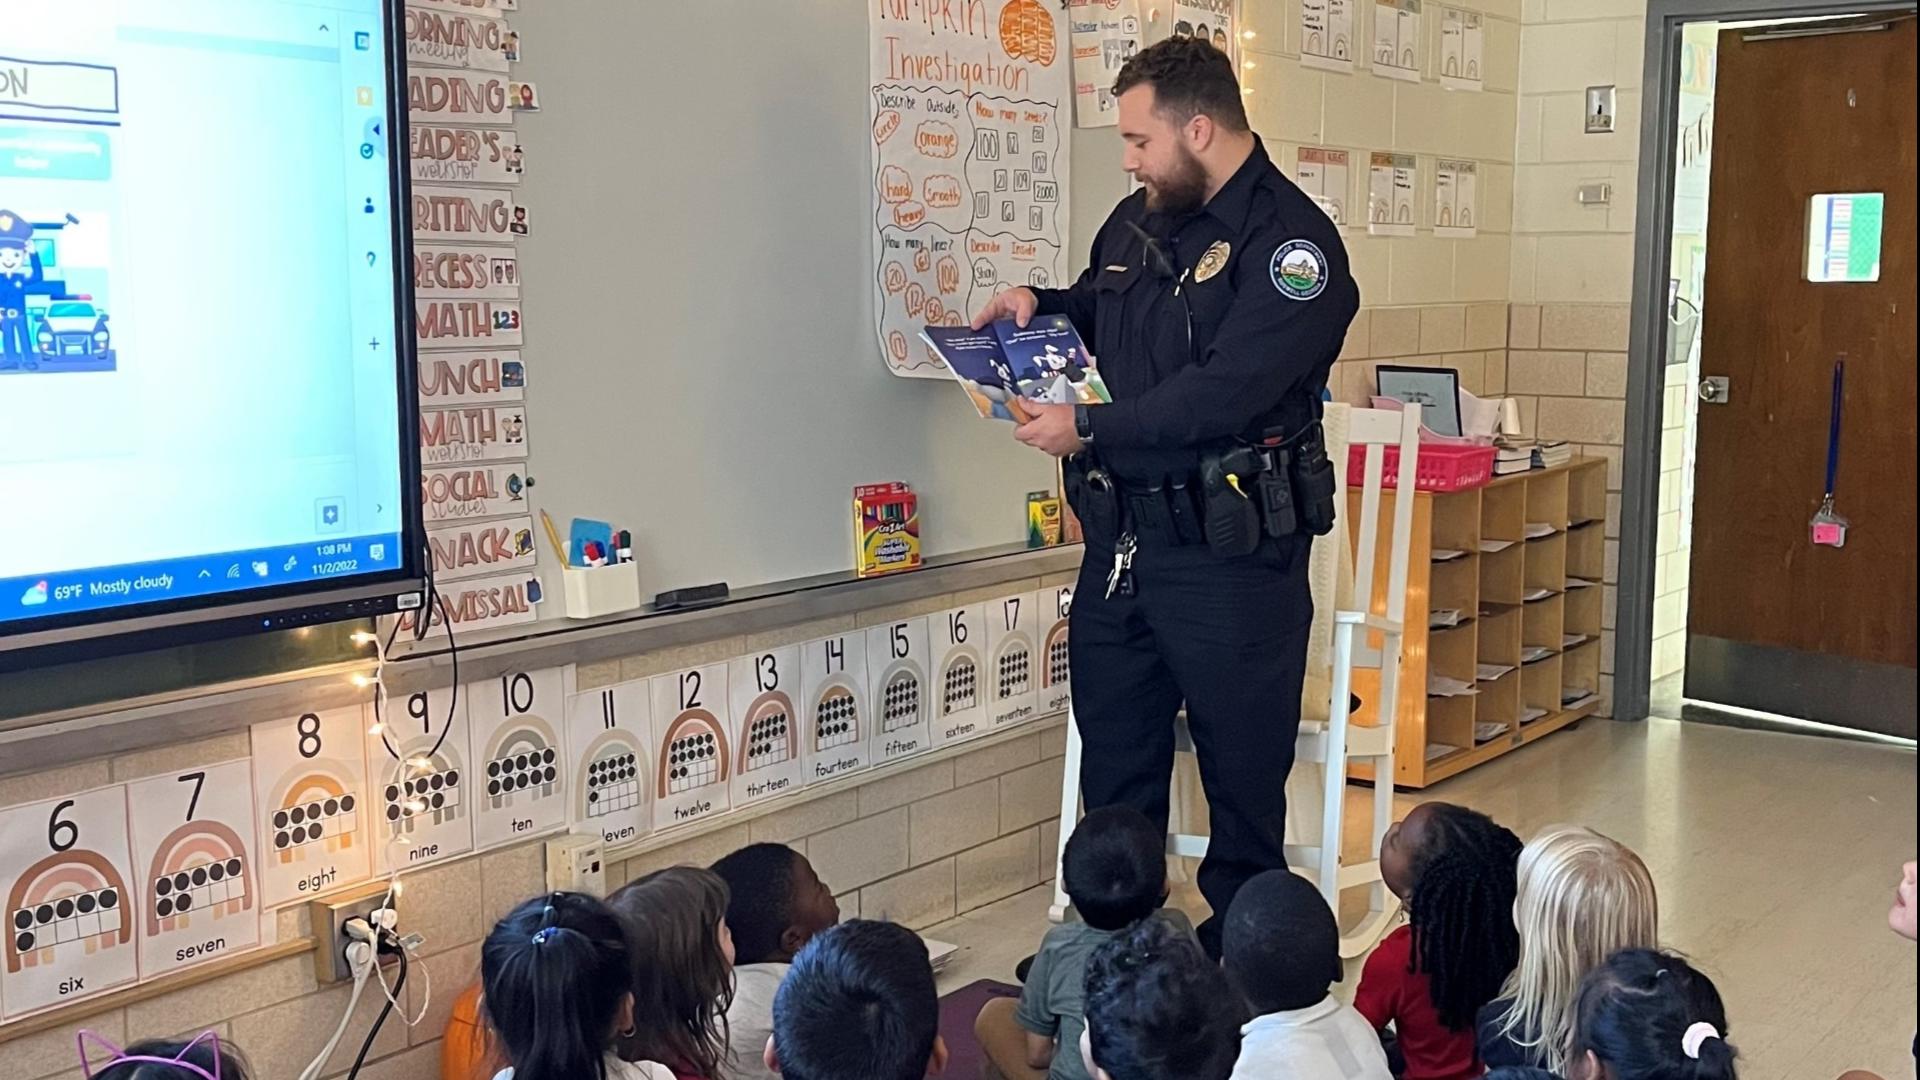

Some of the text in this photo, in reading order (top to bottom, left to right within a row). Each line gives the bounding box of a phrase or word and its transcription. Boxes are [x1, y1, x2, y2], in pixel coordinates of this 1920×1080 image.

[884, 36, 1029, 98] Investigation
[880, 93, 916, 110] Describe
[975, 100, 994, 118] How
[919, 131, 955, 155] orange
[979, 132, 997, 159] 100
[884, 234, 900, 249] How
[416, 302, 492, 338] MATH
[420, 408, 497, 447] MATH
[421, 469, 499, 505] SOCIAL
[431, 498, 488, 518] studies
[316, 543, 352, 556] 1:08 PM
[312, 559, 358, 574] 11/2/2022
[54, 573, 173, 601] 69°F Mostly cloudy
[949, 610, 968, 644] 16
[1003, 598, 1020, 631] 17
[890, 623, 910, 659] 15
[825, 637, 844, 674] 14
[756, 654, 778, 692] 13
[502, 672, 533, 717] 10
[679, 671, 701, 710] 12
[408, 691, 429, 733] 9
[602, 690, 615, 729] 11
[996, 704, 1032, 724] seventeen
[297, 713, 321, 758] 8
[946, 721, 975, 738] sixteen
[885, 738, 917, 757] fifteen
[815, 755, 859, 778] fourteen
[177, 772, 206, 822] 7
[747, 775, 789, 798] thirteen
[674, 799, 711, 820] twelve
[48, 800, 78, 852] 6
[511, 815, 533, 833] ten
[409, 841, 439, 861] nine
[298, 866, 337, 893] eight
[176, 936, 226, 962] seven
[59, 976, 84, 995] six
